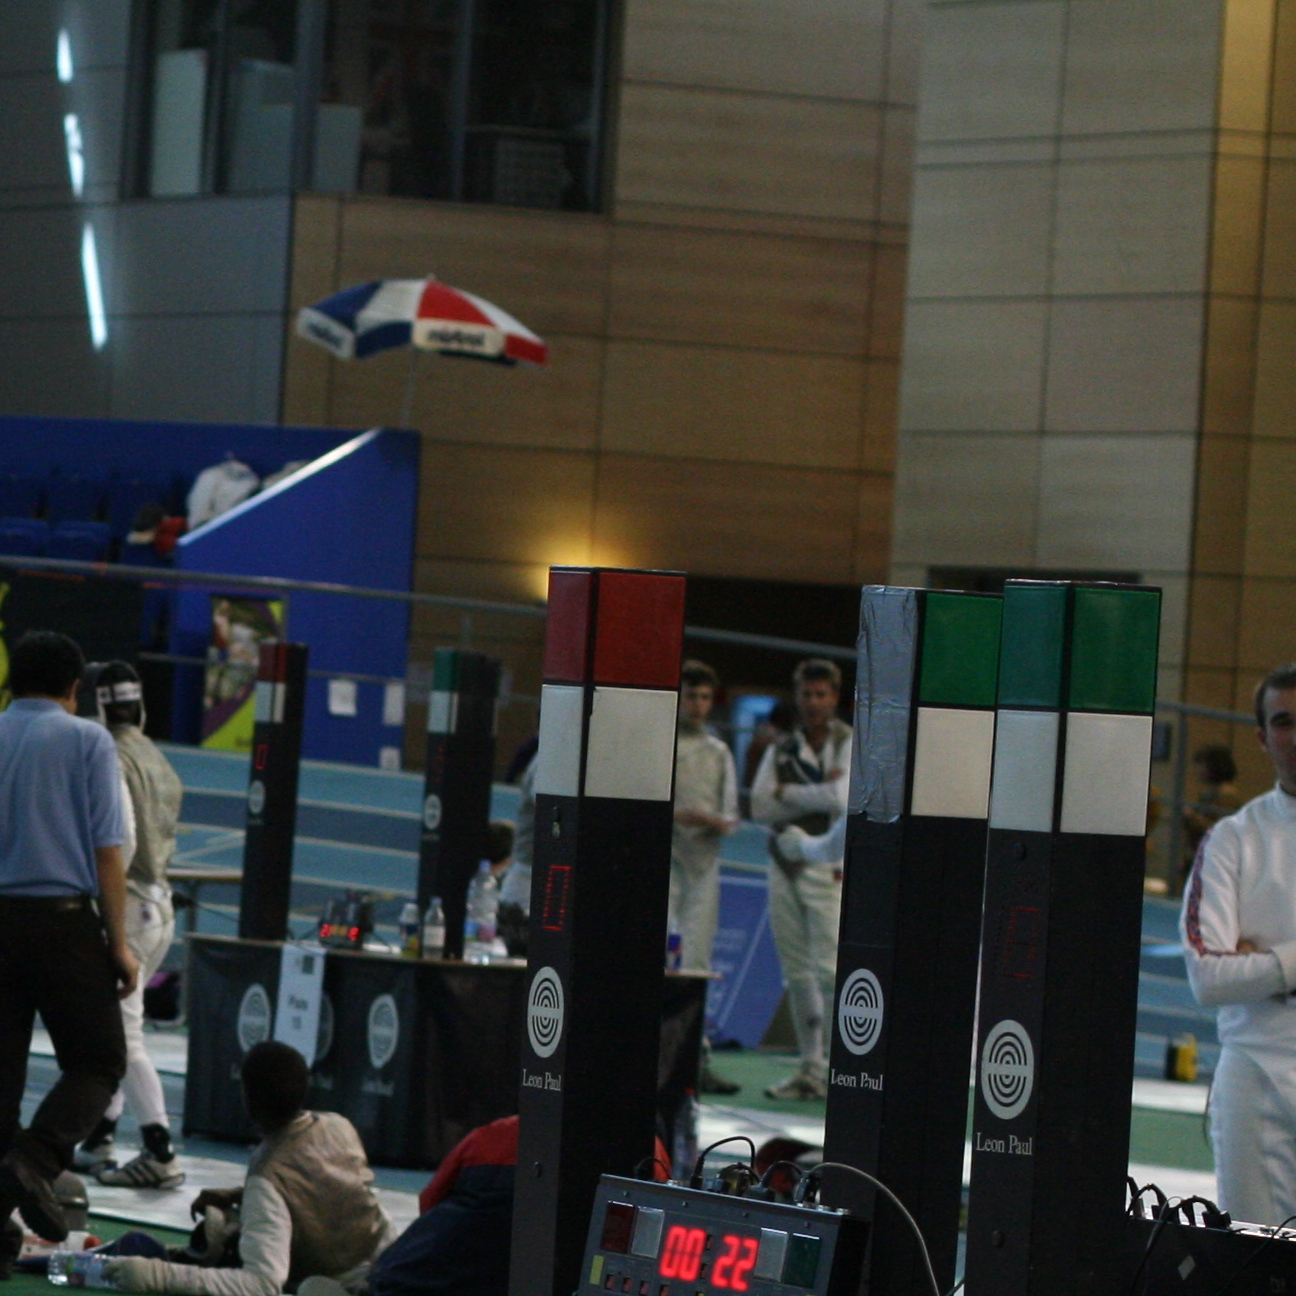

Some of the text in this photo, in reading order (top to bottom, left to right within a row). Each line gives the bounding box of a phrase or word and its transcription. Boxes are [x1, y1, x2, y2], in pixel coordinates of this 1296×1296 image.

[522, 1068, 562, 1091] Leon Paul
[830, 1068, 857, 1088] Leon
[976, 1132, 1033, 1155] Leon Paul
[660, 1225, 759, 1292] 00 22
